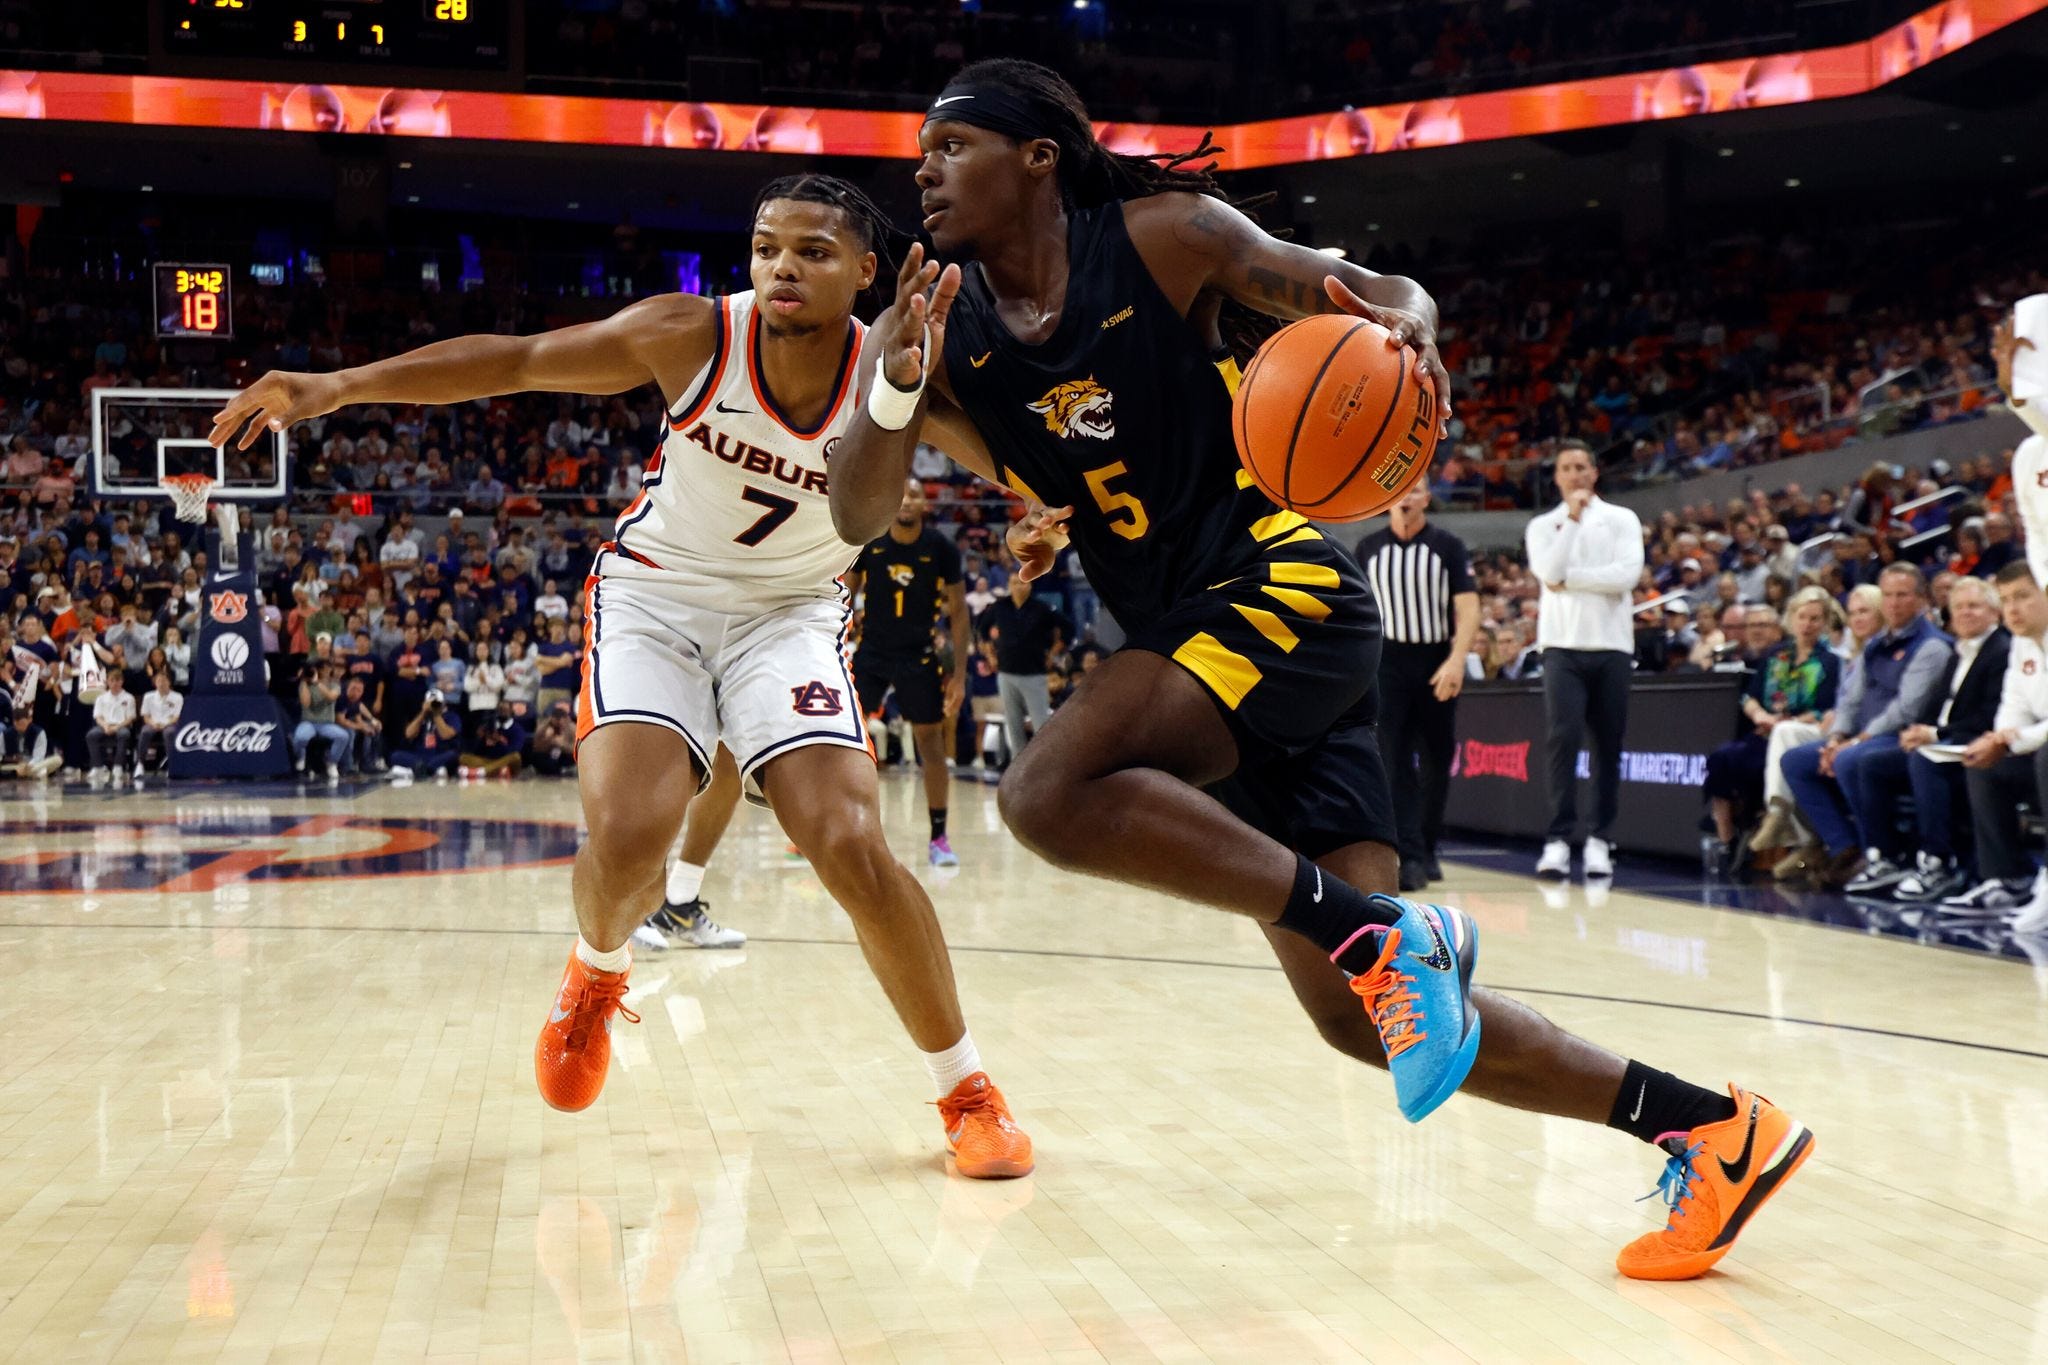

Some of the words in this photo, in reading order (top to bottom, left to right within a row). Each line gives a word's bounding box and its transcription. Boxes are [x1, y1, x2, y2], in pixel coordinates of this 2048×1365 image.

[436, 0, 467, 21] 28
[293, 20, 307, 42] 3
[337, 22, 346, 41] 1
[371, 24, 384, 45] 7
[176, 270, 224, 294] 3:42
[182, 292, 218, 331] 18
[1108, 305, 1134, 327] SWAC
[685, 421, 829, 496] AUBUR
[1082, 460, 1149, 541] 5
[733, 484, 799, 547] 7
[894, 590, 904, 618] 1
